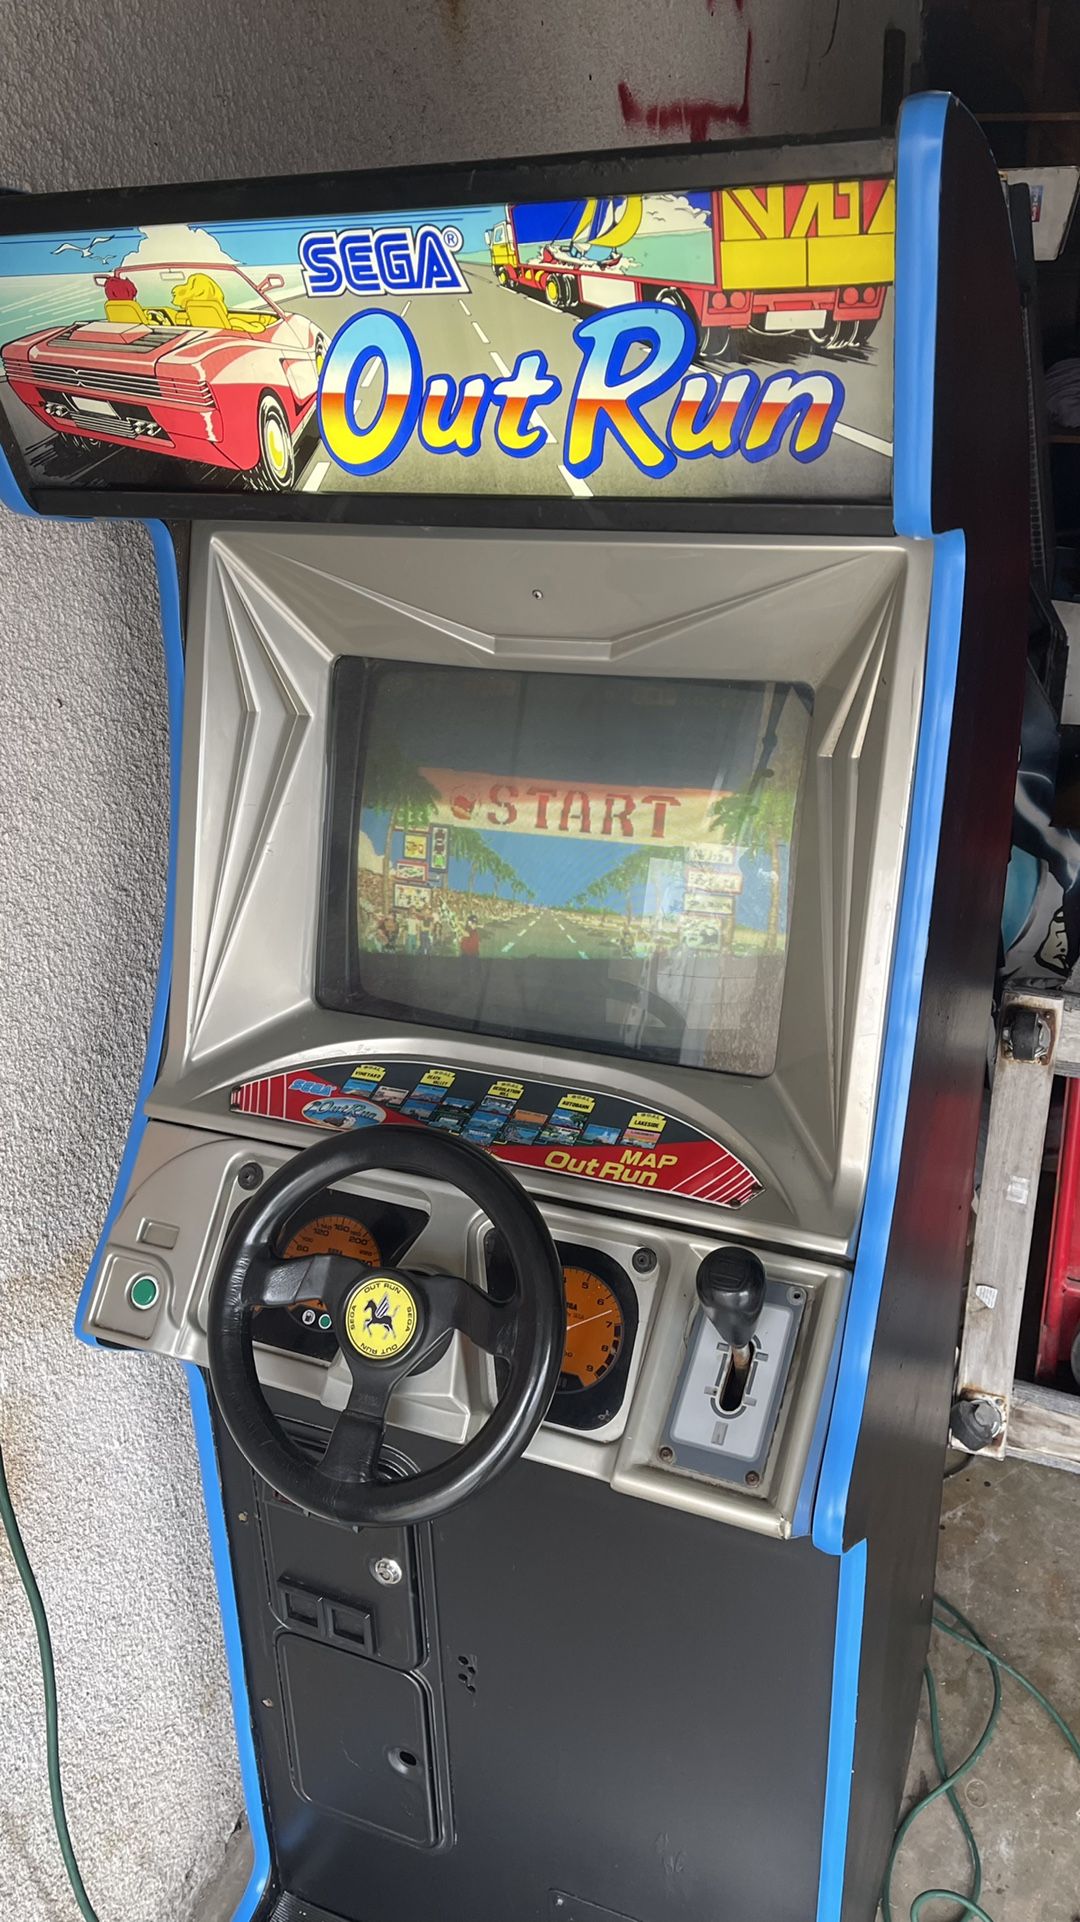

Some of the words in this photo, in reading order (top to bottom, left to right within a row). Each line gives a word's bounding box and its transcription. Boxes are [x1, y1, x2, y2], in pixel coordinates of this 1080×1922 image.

[487, 784, 681, 839] START
[288, 1078, 337, 1097] SEGA
[633, 1119, 660, 1129] LAKESIDE
[620, 1149, 679, 1169] MAP
[348, 1236, 368, 1246] 200
[364, 1283, 381, 1294] OUT
[383, 1283, 402, 1294] RUN
[582, 1282, 589, 1290] 5
[349, 1304, 357, 1330] SEGA
[605, 1321, 613, 1329] 7
[360, 1342, 378, 1355] RUN
[380, 1343, 398, 1355] OUT
[586, 1364, 594, 1373] 9
